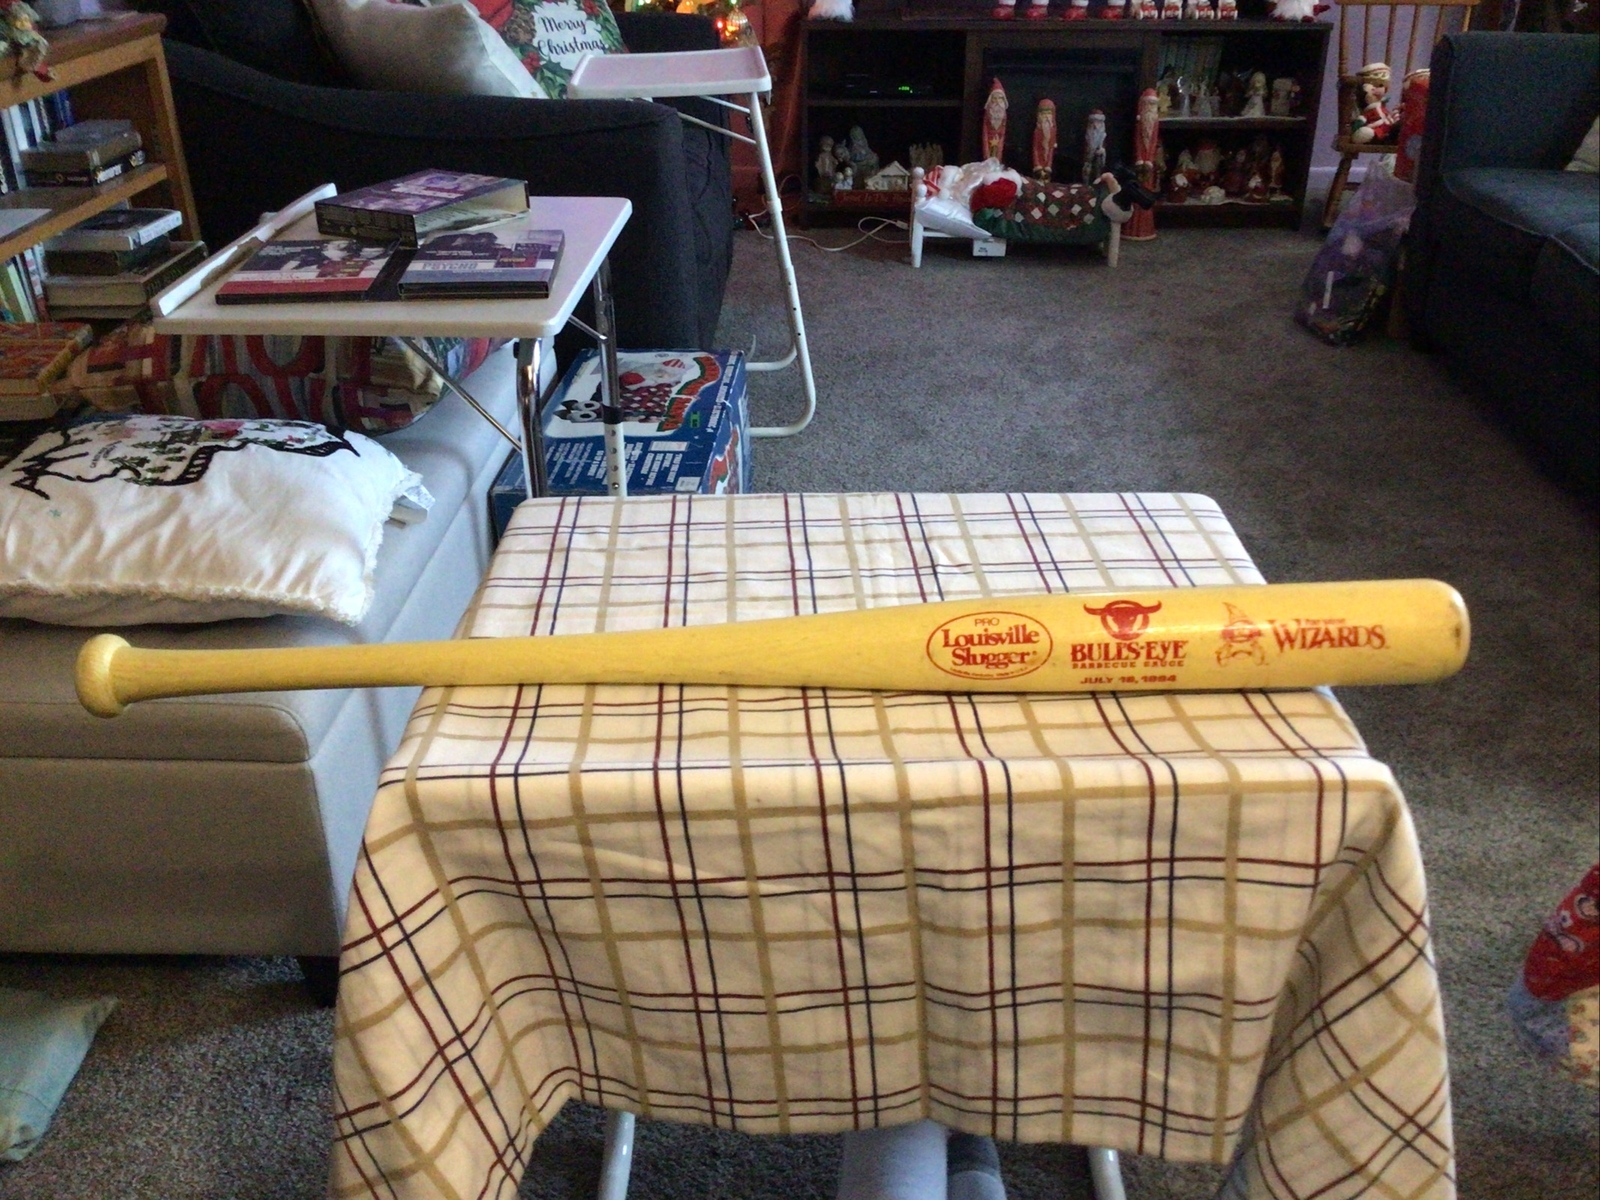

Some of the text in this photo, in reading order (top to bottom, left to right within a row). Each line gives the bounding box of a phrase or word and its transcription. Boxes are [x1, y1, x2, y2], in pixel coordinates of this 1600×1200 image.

[538, 16, 587, 34] Merry
[537, 37, 606, 59] Christmas
[974, 617, 1000, 627] PRO
[941, 624, 1040, 648] Louisville
[1267, 618, 1386, 653] WIZARDS
[951, 647, 1031, 670] Slugger
[1072, 660, 1185, 670] BARBECUE SAUCE
[1080, 676, 1114, 684] JULY
